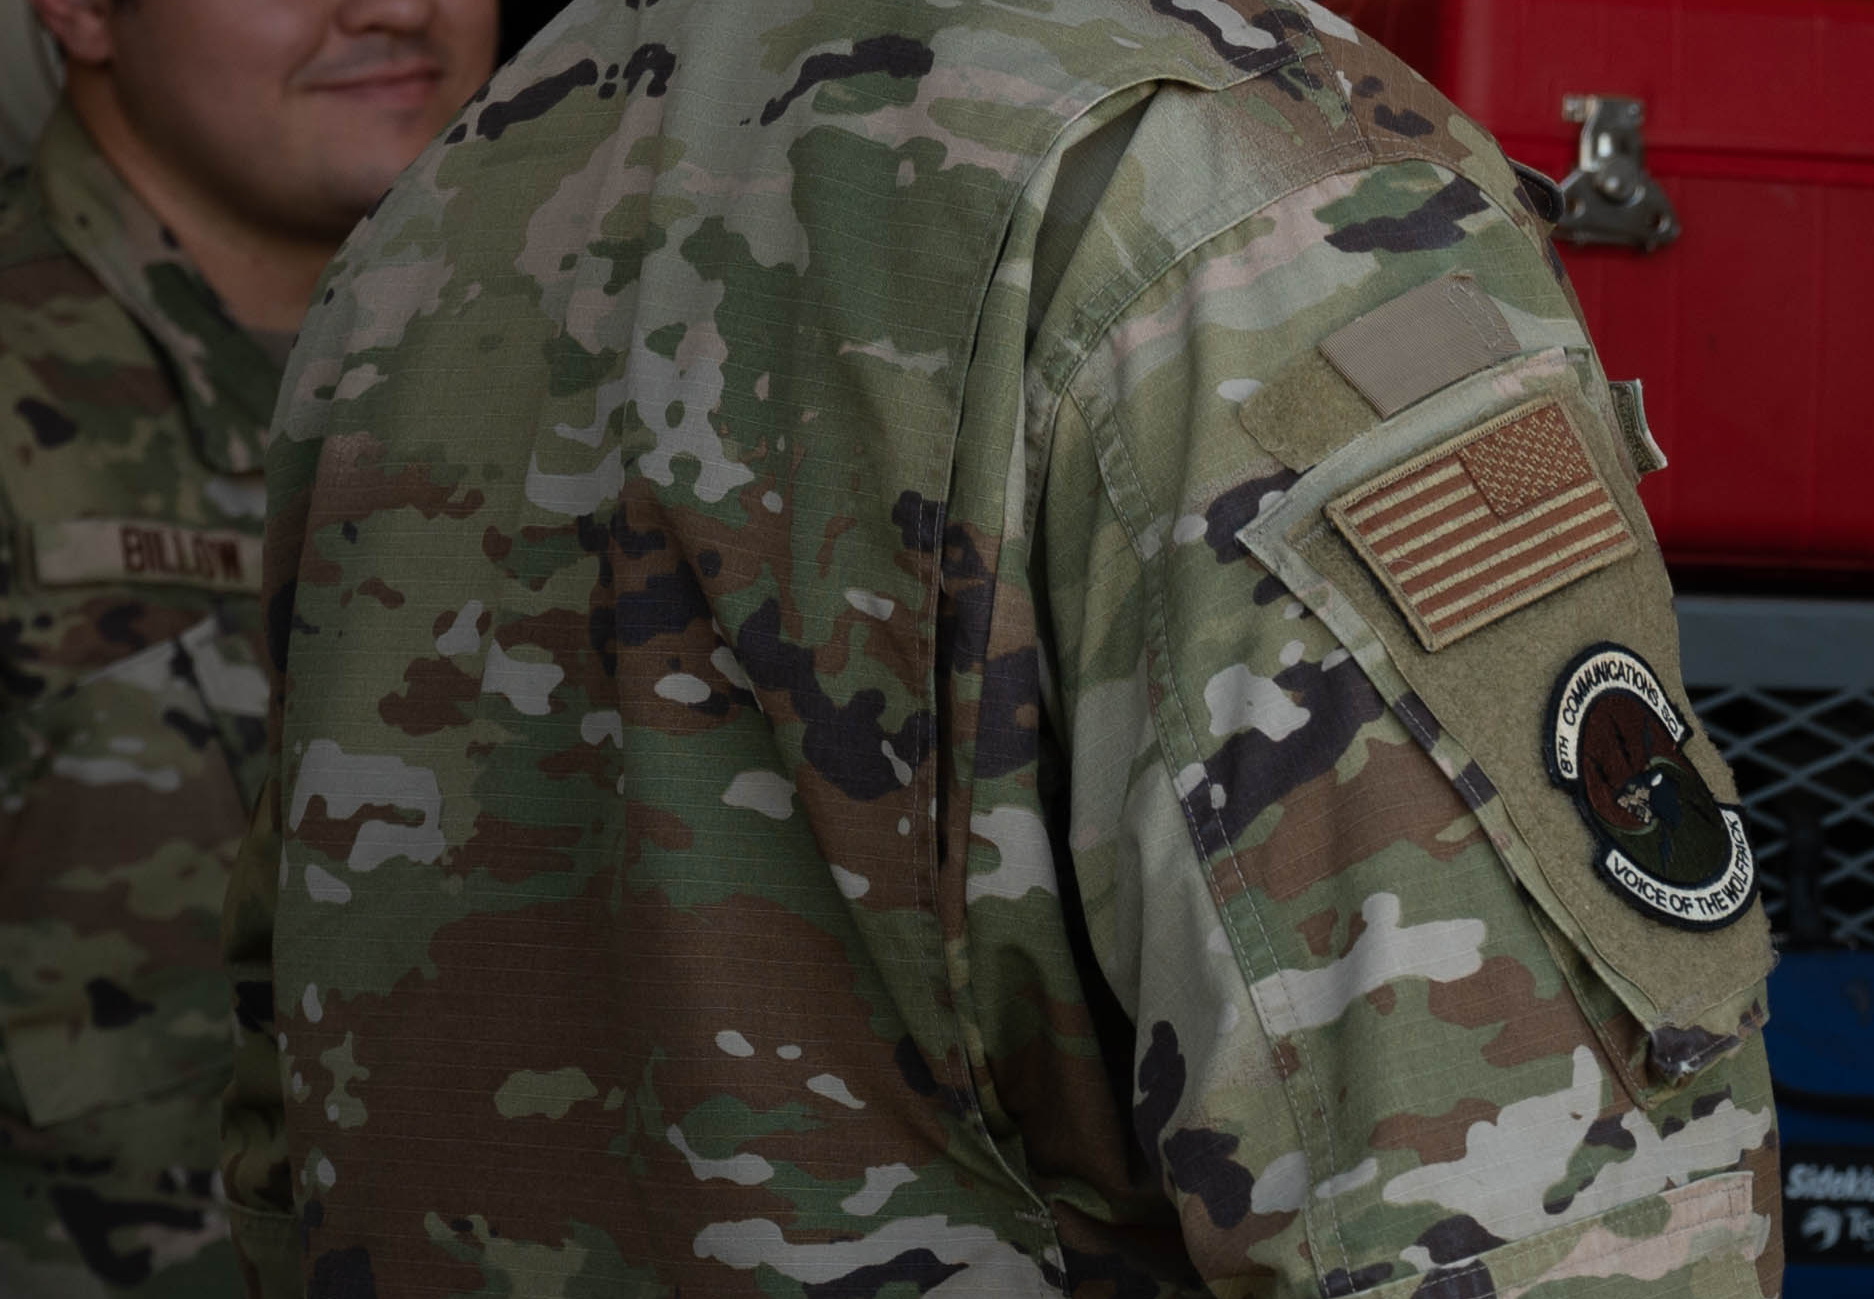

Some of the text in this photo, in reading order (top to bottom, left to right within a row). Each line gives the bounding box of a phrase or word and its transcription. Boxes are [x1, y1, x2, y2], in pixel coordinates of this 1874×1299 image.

[121, 525, 244, 581] BILLOW
[1562, 659, 1660, 727] COMMUNICATIONS
[1559, 734, 1575, 775] 8TH
[1613, 818, 1753, 917] VOICE OF THE WOLFPACK
